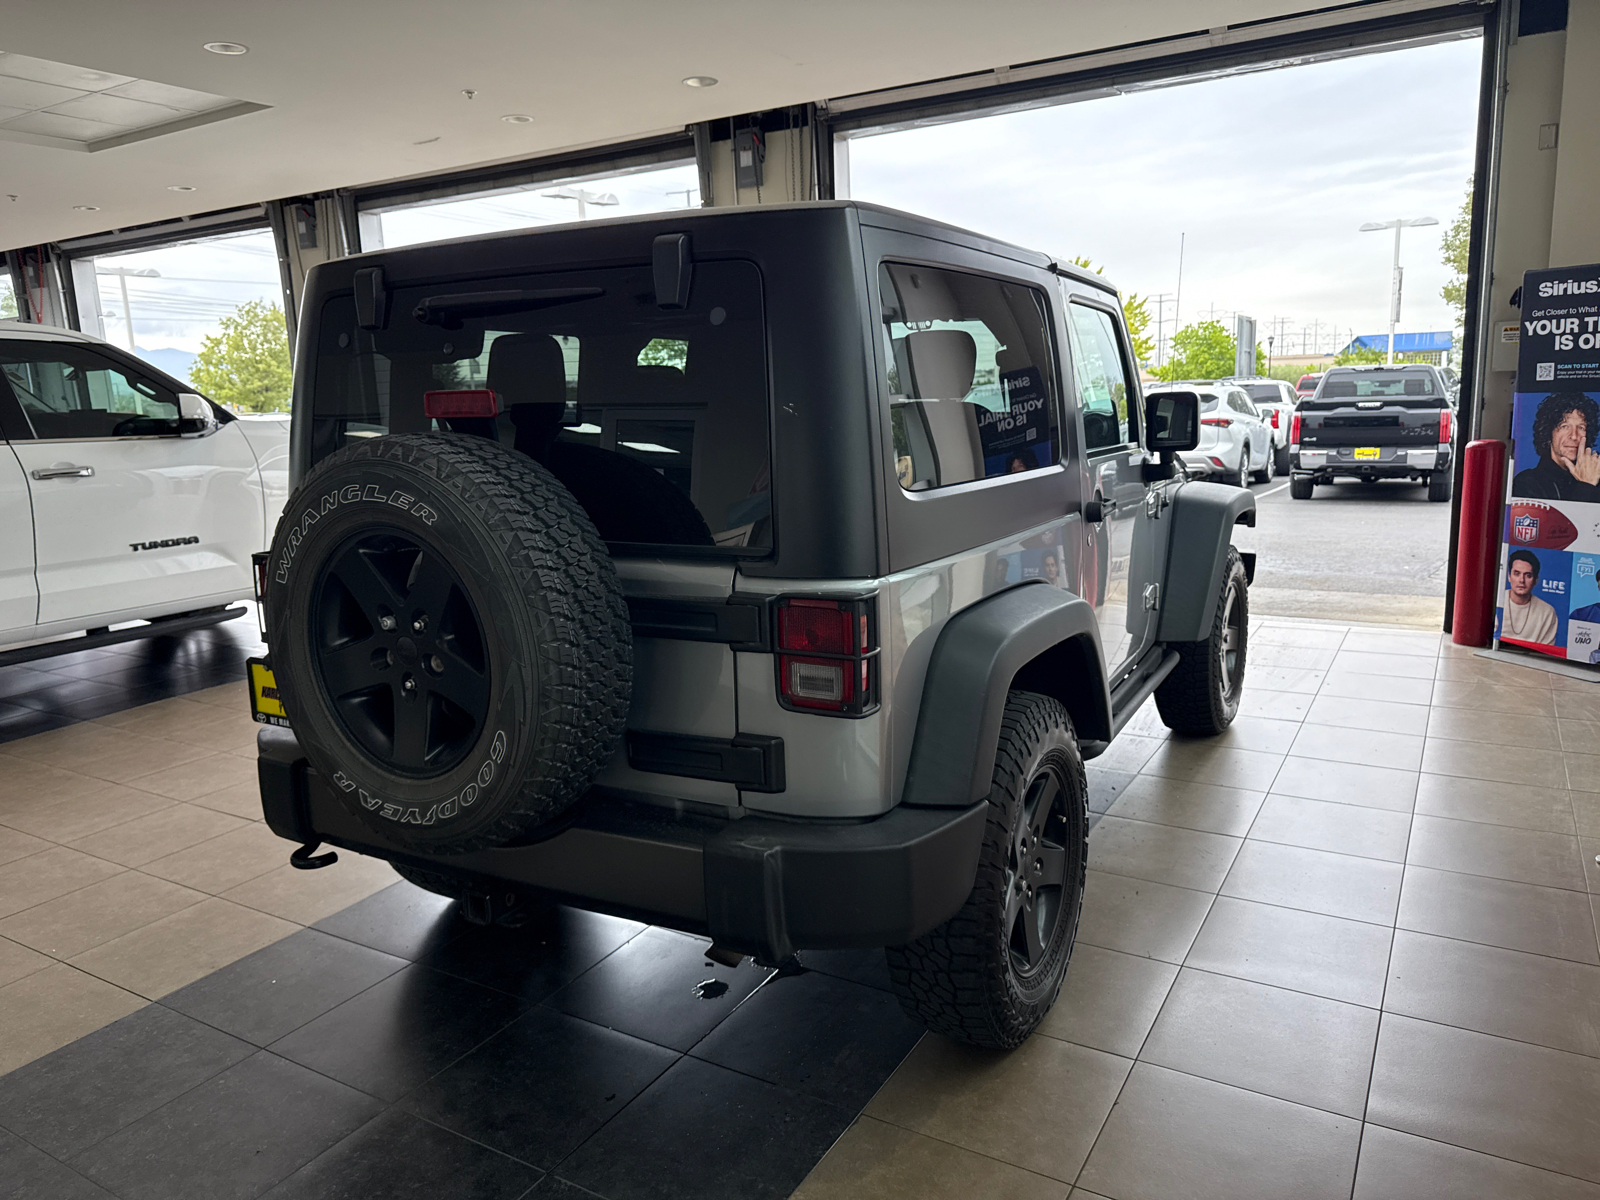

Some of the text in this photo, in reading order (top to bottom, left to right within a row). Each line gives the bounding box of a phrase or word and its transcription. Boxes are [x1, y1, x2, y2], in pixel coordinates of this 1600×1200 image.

[1538, 277, 1600, 298] Sirius
[1532, 309, 1545, 317] Get
[1545, 308, 1568, 316] Closer
[1524, 316, 1600, 336] YOUR T
[1554, 334, 1574, 351] IS
[275, 484, 438, 585] WRANGLER
[1516, 526, 1536, 541] NFL
[129, 535, 200, 551] TUNDRA
[1542, 579, 1566, 590] LIFE
[332, 730, 507, 825] GOODYEAR
